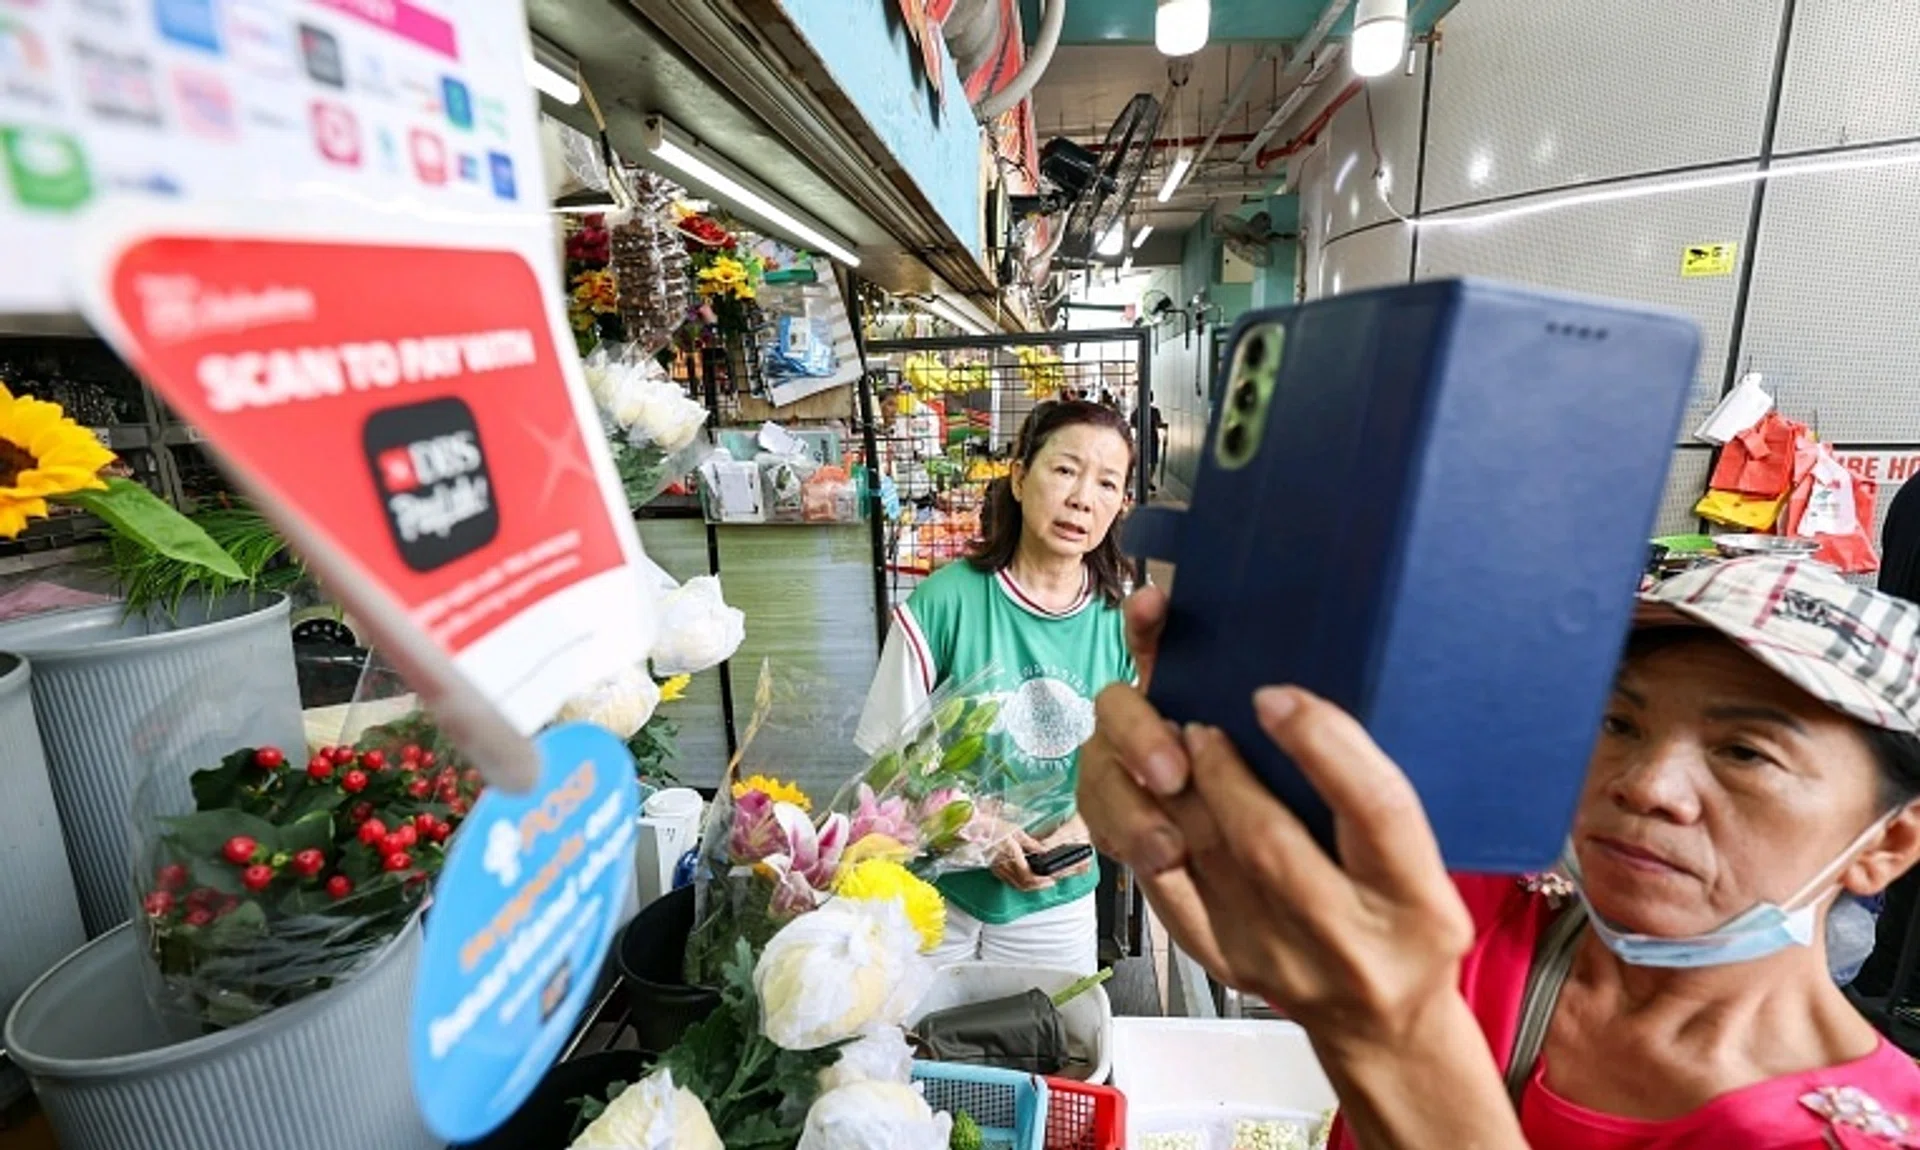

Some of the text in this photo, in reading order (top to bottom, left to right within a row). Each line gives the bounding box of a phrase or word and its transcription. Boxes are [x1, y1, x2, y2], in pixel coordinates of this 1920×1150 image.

[196, 349, 346, 412] SCAN
[339, 339, 400, 391] TO
[397, 331, 463, 384] PAY
